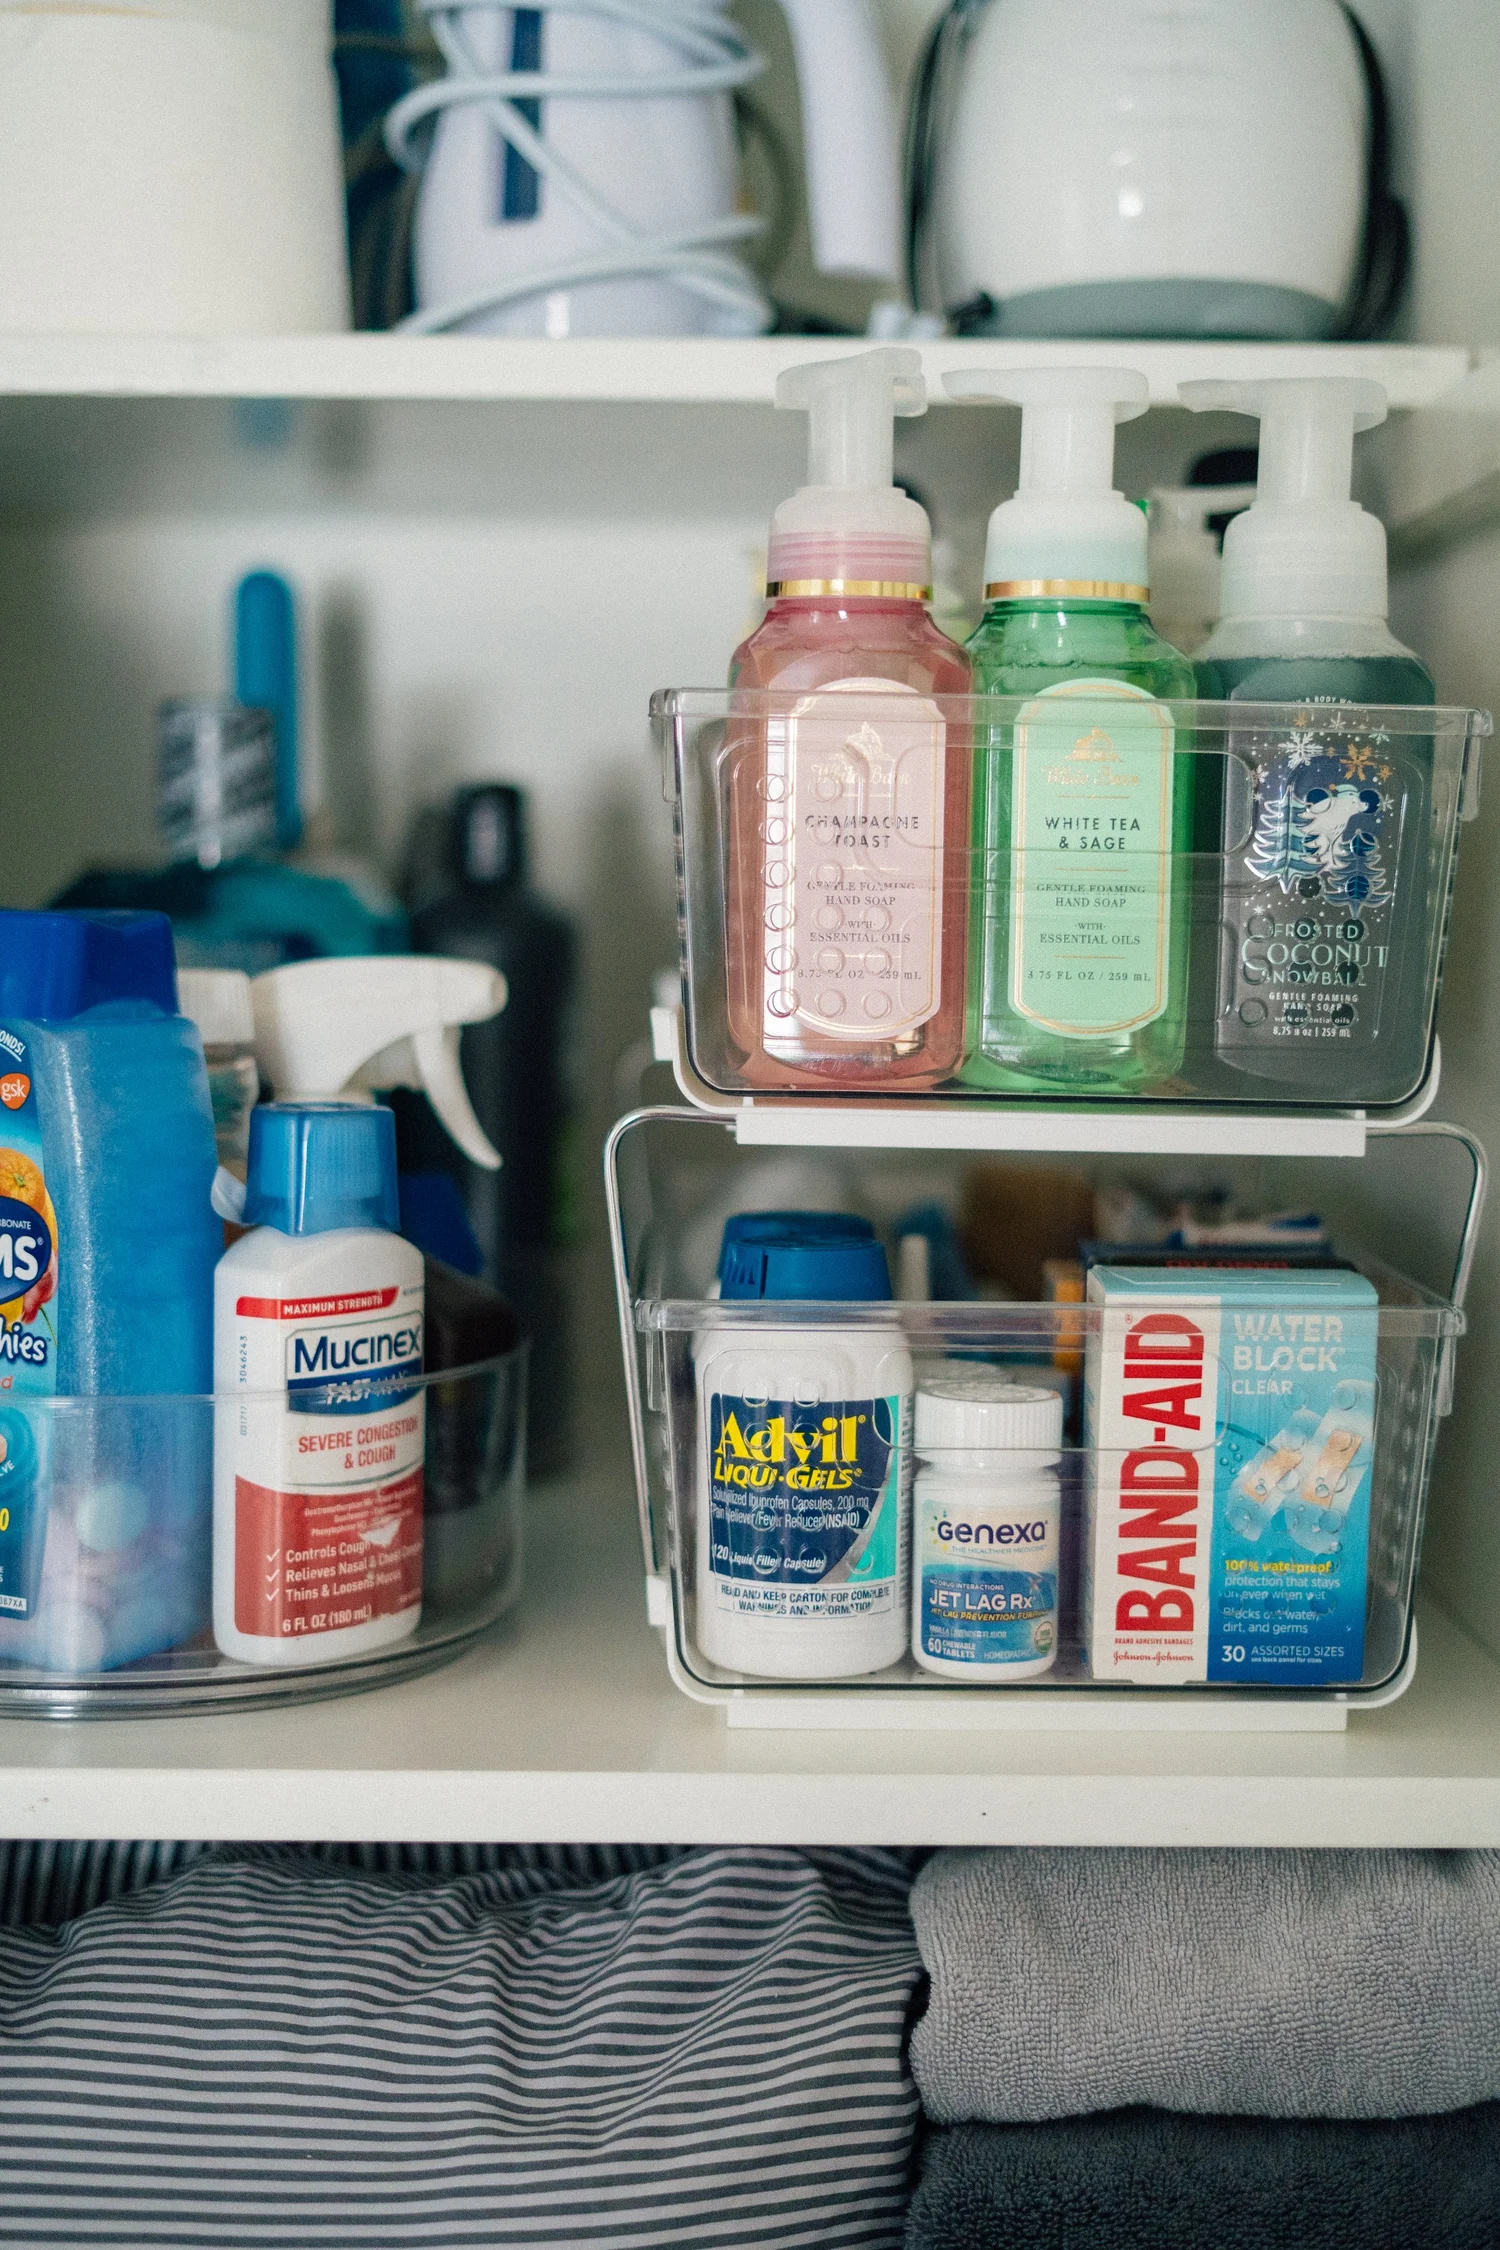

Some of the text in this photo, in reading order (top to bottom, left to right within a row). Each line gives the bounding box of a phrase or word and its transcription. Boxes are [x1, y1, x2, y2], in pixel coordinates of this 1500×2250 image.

[1045, 817, 1141, 831] WHITE TEA
[1059, 836, 1126, 850] & SAGE
[1036, 884, 1146, 893] GENTLE FOAMING
[826, 895, 896, 906] HAND SOAP
[1055, 897, 1127, 909] HAND SOAP
[809, 932, 911, 943] ESSENTIAL OILS
[1039, 934, 1141, 946] ESSENTIAL OILS
[1273, 923, 1359, 940] FROSTED
[1241, 934, 1389, 971] COCONUT
[903, 972, 922, 980] mL
[1057, 971, 1072, 980] FL
[1077, 971, 1095, 980] OZ
[1108, 972, 1128, 981] 259
[1133, 973, 1151, 981] mL
[1268, 992, 1359, 1003] GENTLE FOAMING
[1272, 1026, 1292, 1036] 8.75
[1321, 1027, 1336, 1038] 259
[0, 1029, 26, 1056] ONDS!
[1, 1079, 27, 1101] gsk
[284, 1295, 383, 1315] MAXIMUM STRENGTH
[1233, 1314, 1344, 1343] WATER
[239, 1335, 248, 1383] 3046243
[1233, 1345, 1338, 1372] BLOCK
[1231, 1379, 1294, 1396] CLEAR
[298, 1430, 353, 1453] SEVERE
[714, 1411, 858, 1464] Advil
[344, 1444, 397, 1469] & COUGH
[1115, 1313, 1205, 1633] BAND-AID
[749, 1492, 789, 1509] Ibuprofen
[791, 1495, 835, 1511] Capsules,
[837, 1496, 855, 1509] 200
[856, 1497, 869, 1509] mg
[711, 1502, 725, 1519] Pain
[825, 1512, 860, 1530] (NSAID)
[937, 1520, 1046, 1545] Genexa
[286, 1540, 371, 1563] Controls Cough
[713, 1544, 729, 1561] 120
[783, 1557, 826, 1570] Capsules
[286, 1567, 336, 1582] Relieves
[338, 1560, 367, 1574] Nasal
[1225, 1560, 1333, 1575] 100% waterproof
[286, 1586, 319, 1601] Thins
[321, 1584, 330, 1597] &
[333, 1575, 375, 1595] Loosens
[939, 1580, 955, 1588] DRUG
[955, 1582, 1005, 1591] INTERACTIONS
[1224, 1575, 1341, 1590] protection that stays
[743, 1589, 760, 1600] AND
[789, 1593, 826, 1603] CARTON
[831, 1592, 849, 1603] FOR
[929, 1588, 1033, 1611] JET LAG Rx
[1241, 1590, 1269, 1600] even
[1305, 1590, 1326, 1601] wet
[282, 1603, 373, 1632] 6 FL OZ (180 mL)
[942, 1609, 958, 1619] LAG
[960, 1612, 1015, 1621] PREVENTION
[1285, 1609, 1320, 1622] water,
[1222, 1622, 1309, 1636] dirt, and germs
[927, 1637, 942, 1654] 60
[1115, 1637, 1133, 1645] BRAND
[943, 1647, 976, 1659] TABLETS
[1221, 1645, 1345, 1663] 30 ASSORTED SIZES
